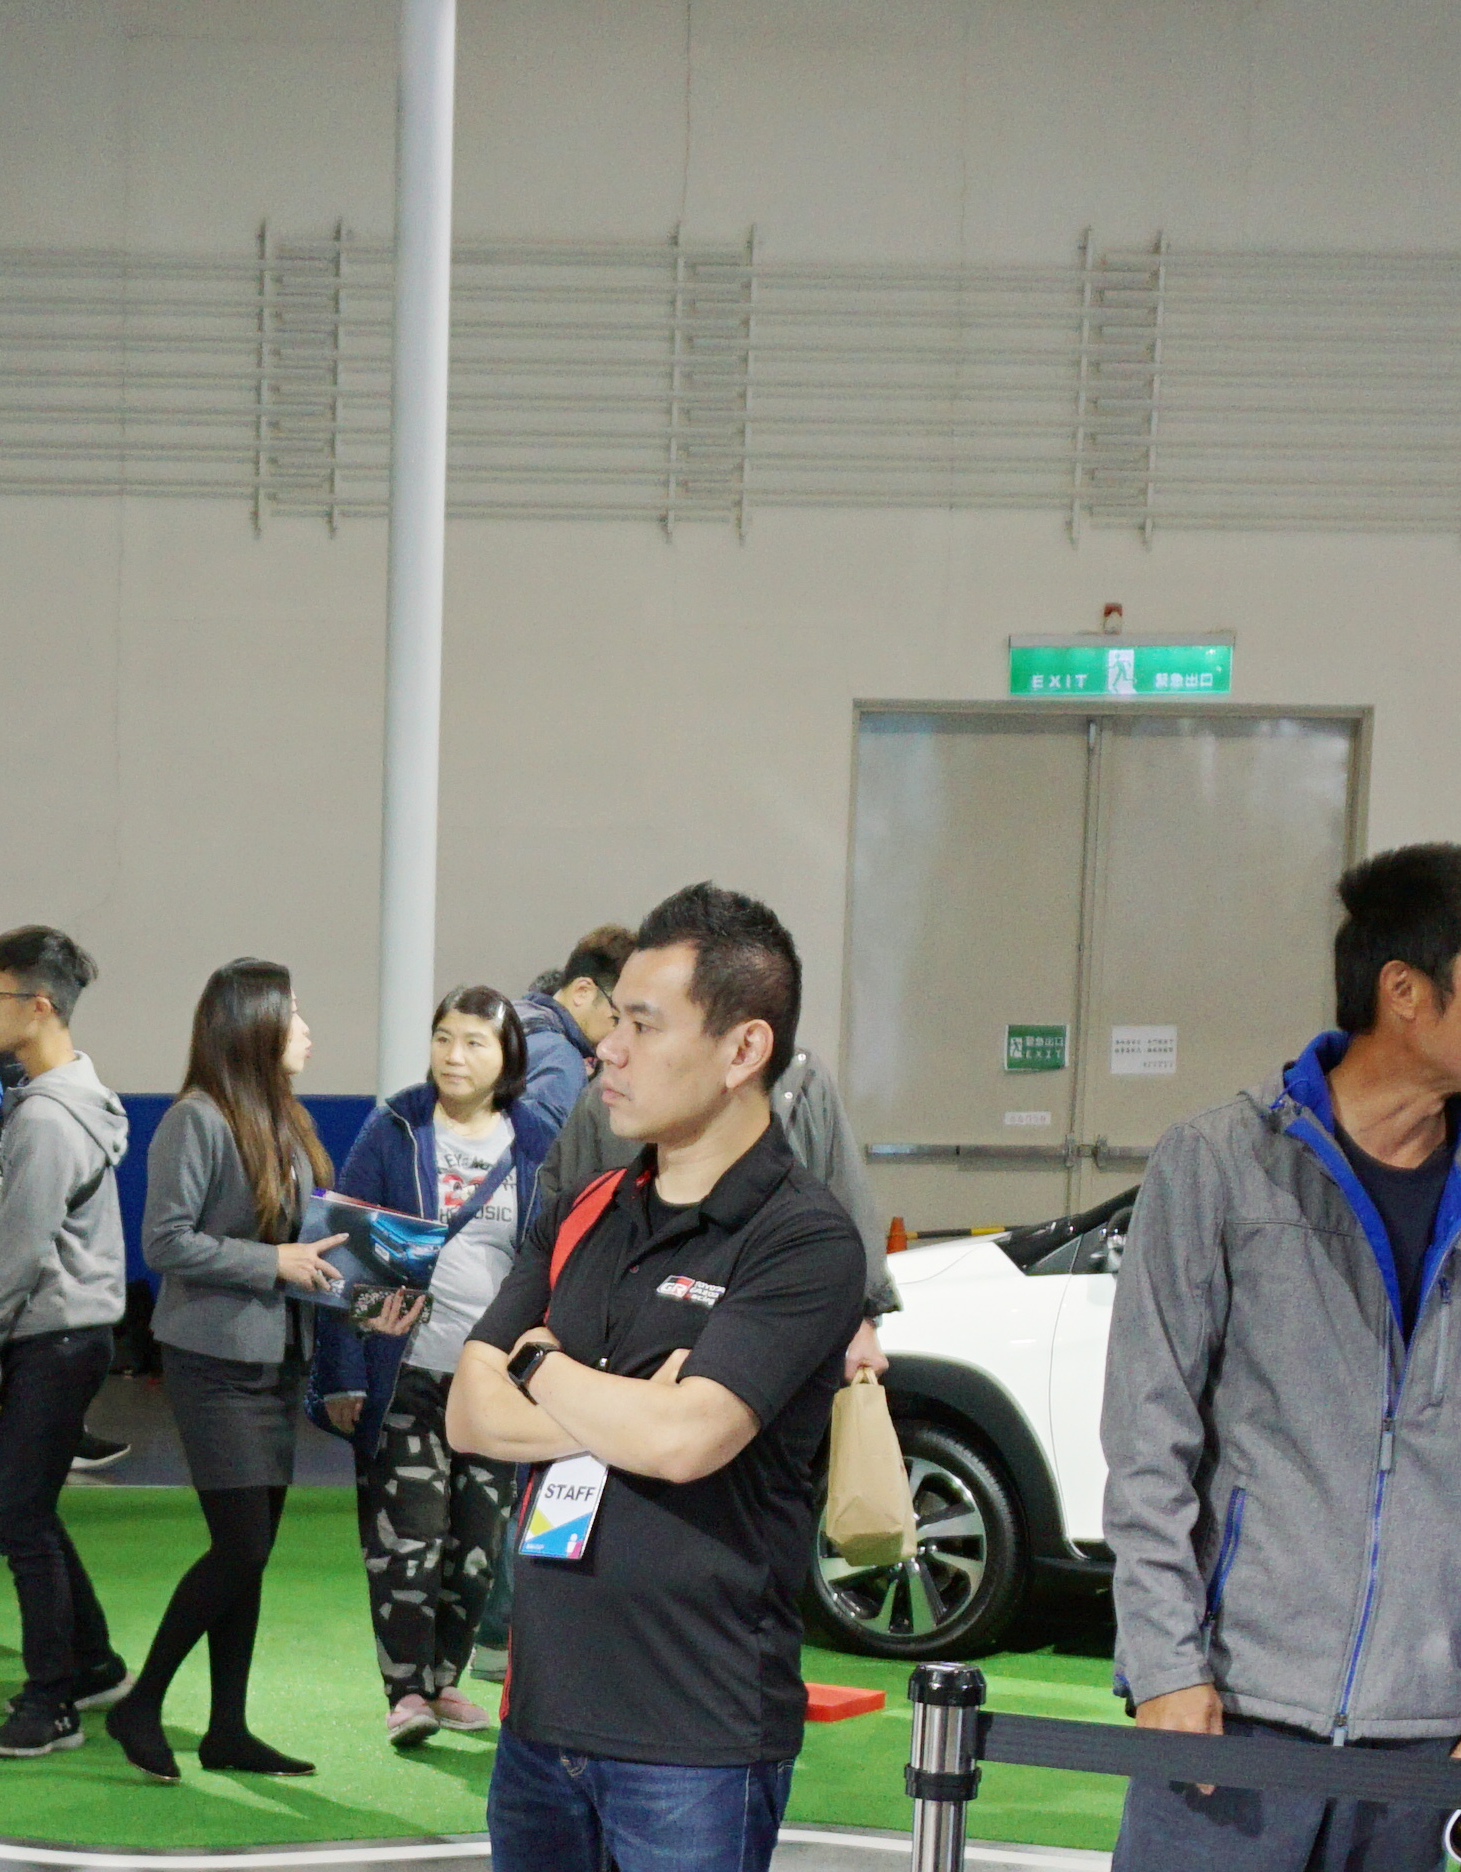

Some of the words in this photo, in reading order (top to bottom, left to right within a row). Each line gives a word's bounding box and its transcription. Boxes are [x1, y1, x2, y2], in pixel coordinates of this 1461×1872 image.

[1031, 673, 1088, 689] EXIT
[1025, 1049, 1061, 1059] EXIT
[660, 1282, 689, 1297] GR
[544, 1483, 596, 1502] STAFF
